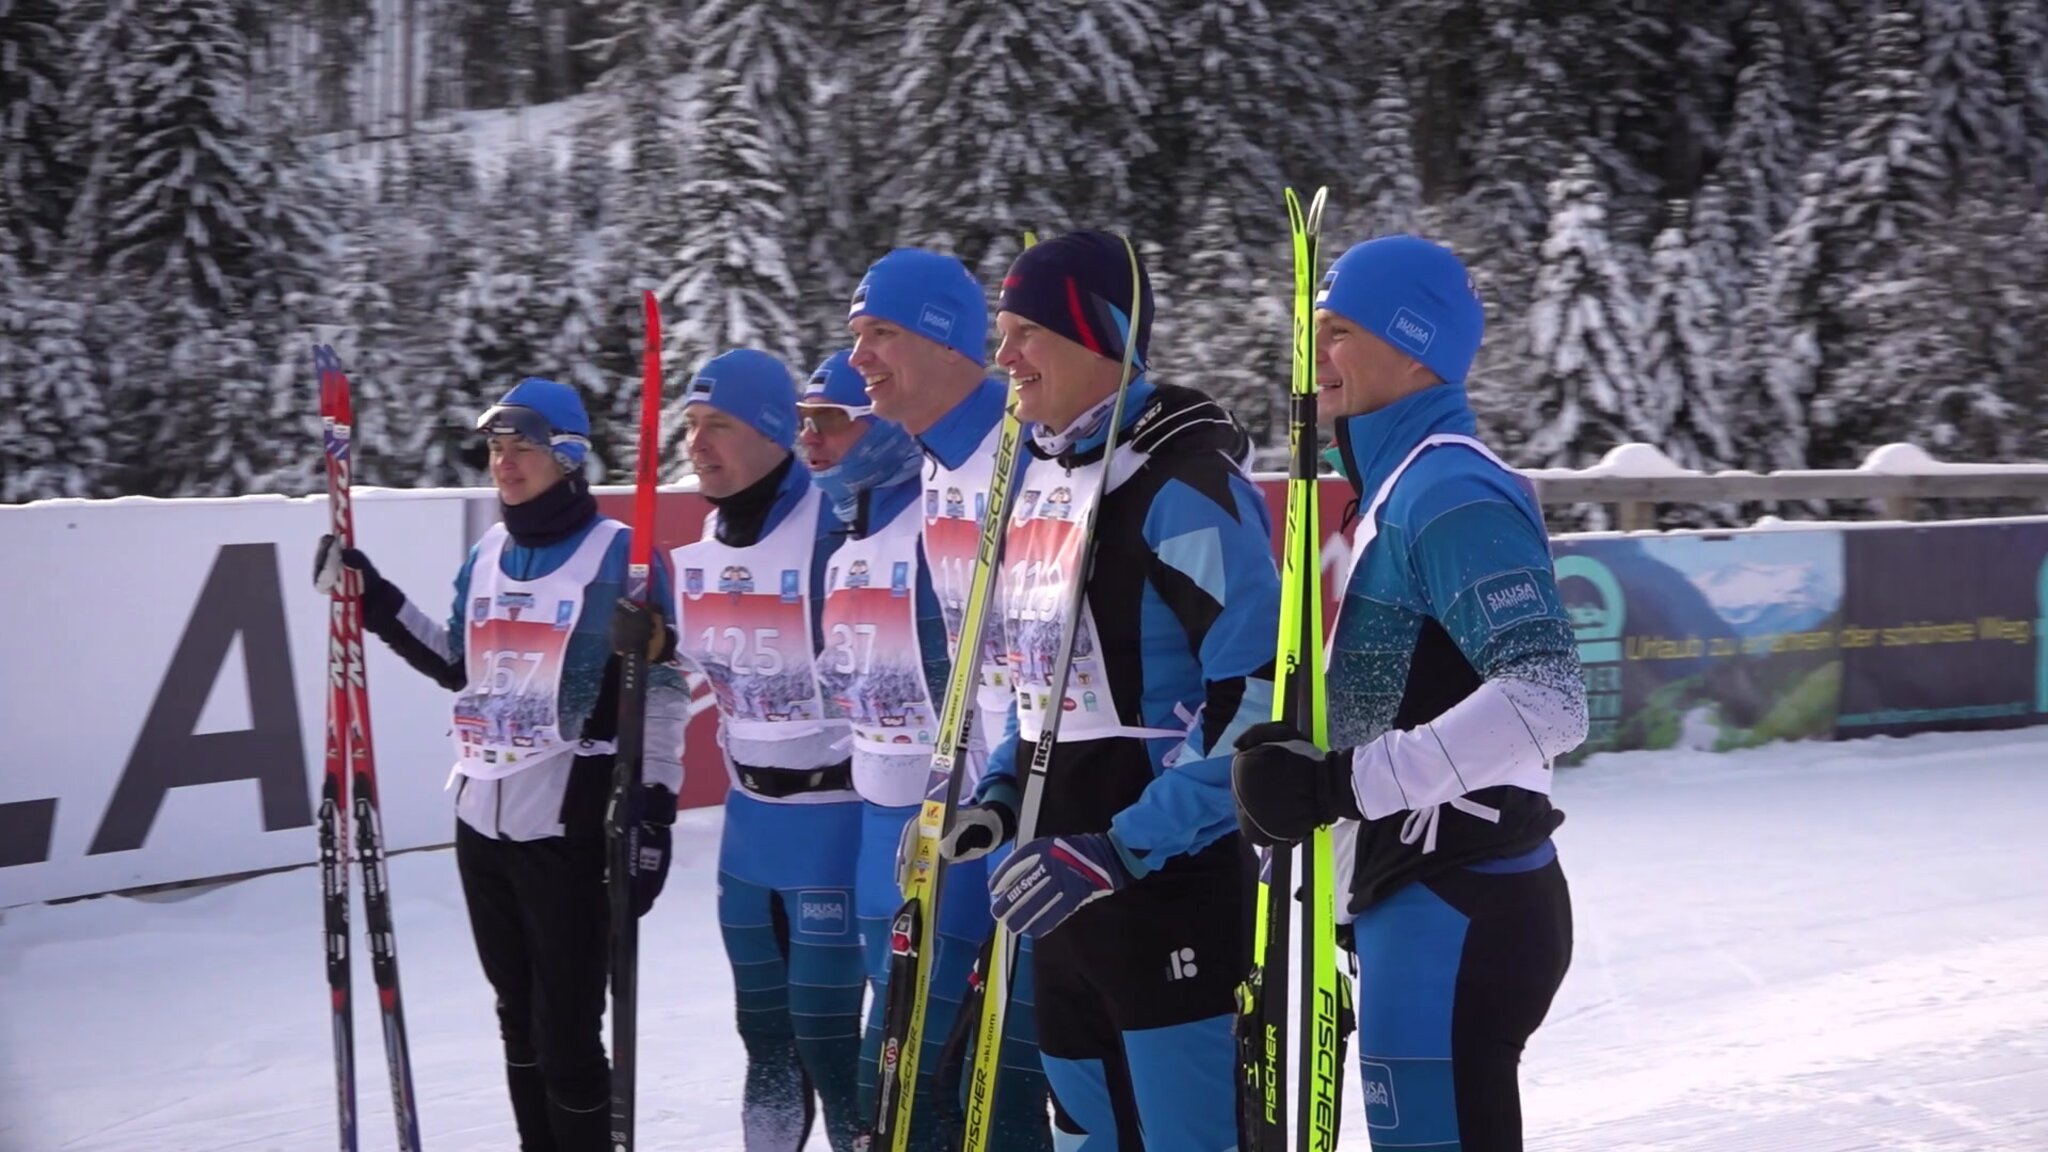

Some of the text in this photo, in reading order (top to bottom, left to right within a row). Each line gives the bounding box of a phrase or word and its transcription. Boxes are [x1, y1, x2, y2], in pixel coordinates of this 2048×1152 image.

[980, 432, 1015, 567] FISCHER
[1486, 583, 1534, 604] SUUSA
[475, 650, 545, 697] 167
[702, 626, 783, 677] 125
[832, 623, 877, 675] 37
[1034, 730, 1052, 768] RCS
[1265, 1023, 1278, 1126] FISCHER
[1314, 987, 1335, 1152] FISCHER
